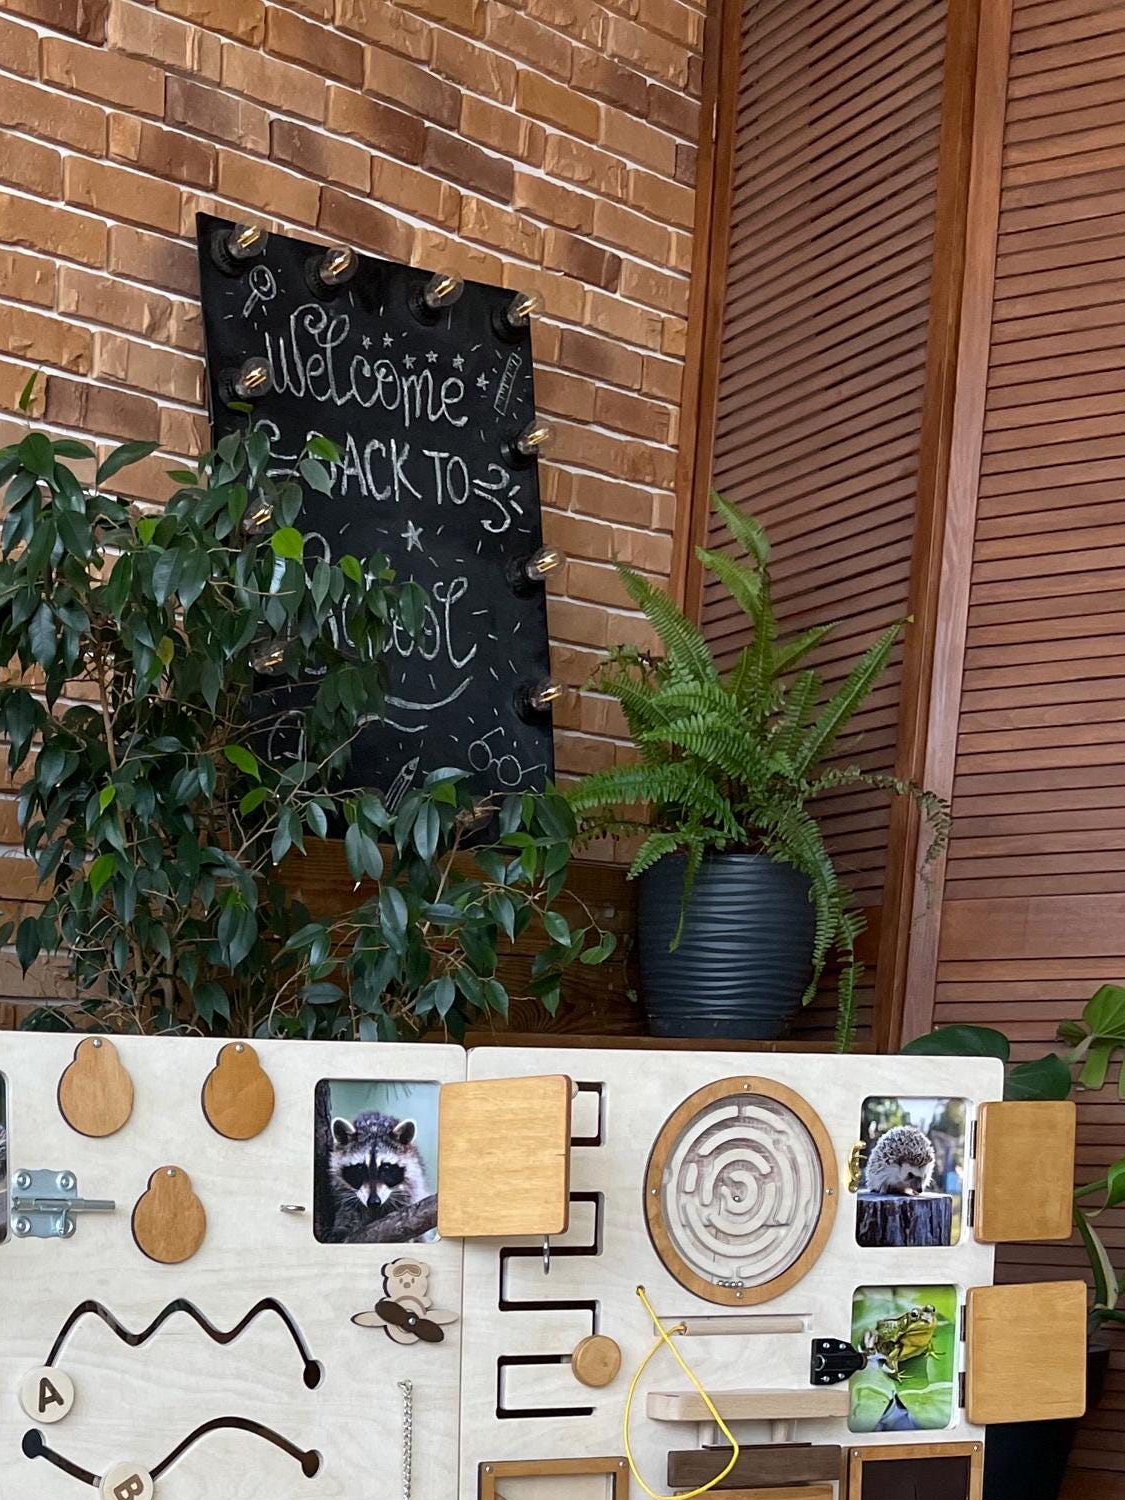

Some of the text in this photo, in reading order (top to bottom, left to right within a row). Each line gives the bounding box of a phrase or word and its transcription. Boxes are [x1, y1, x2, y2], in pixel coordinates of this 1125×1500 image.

[264, 303, 469, 428] Welcome
[422, 449, 470, 505] TO
[38, 1377, 65, 1413] A
